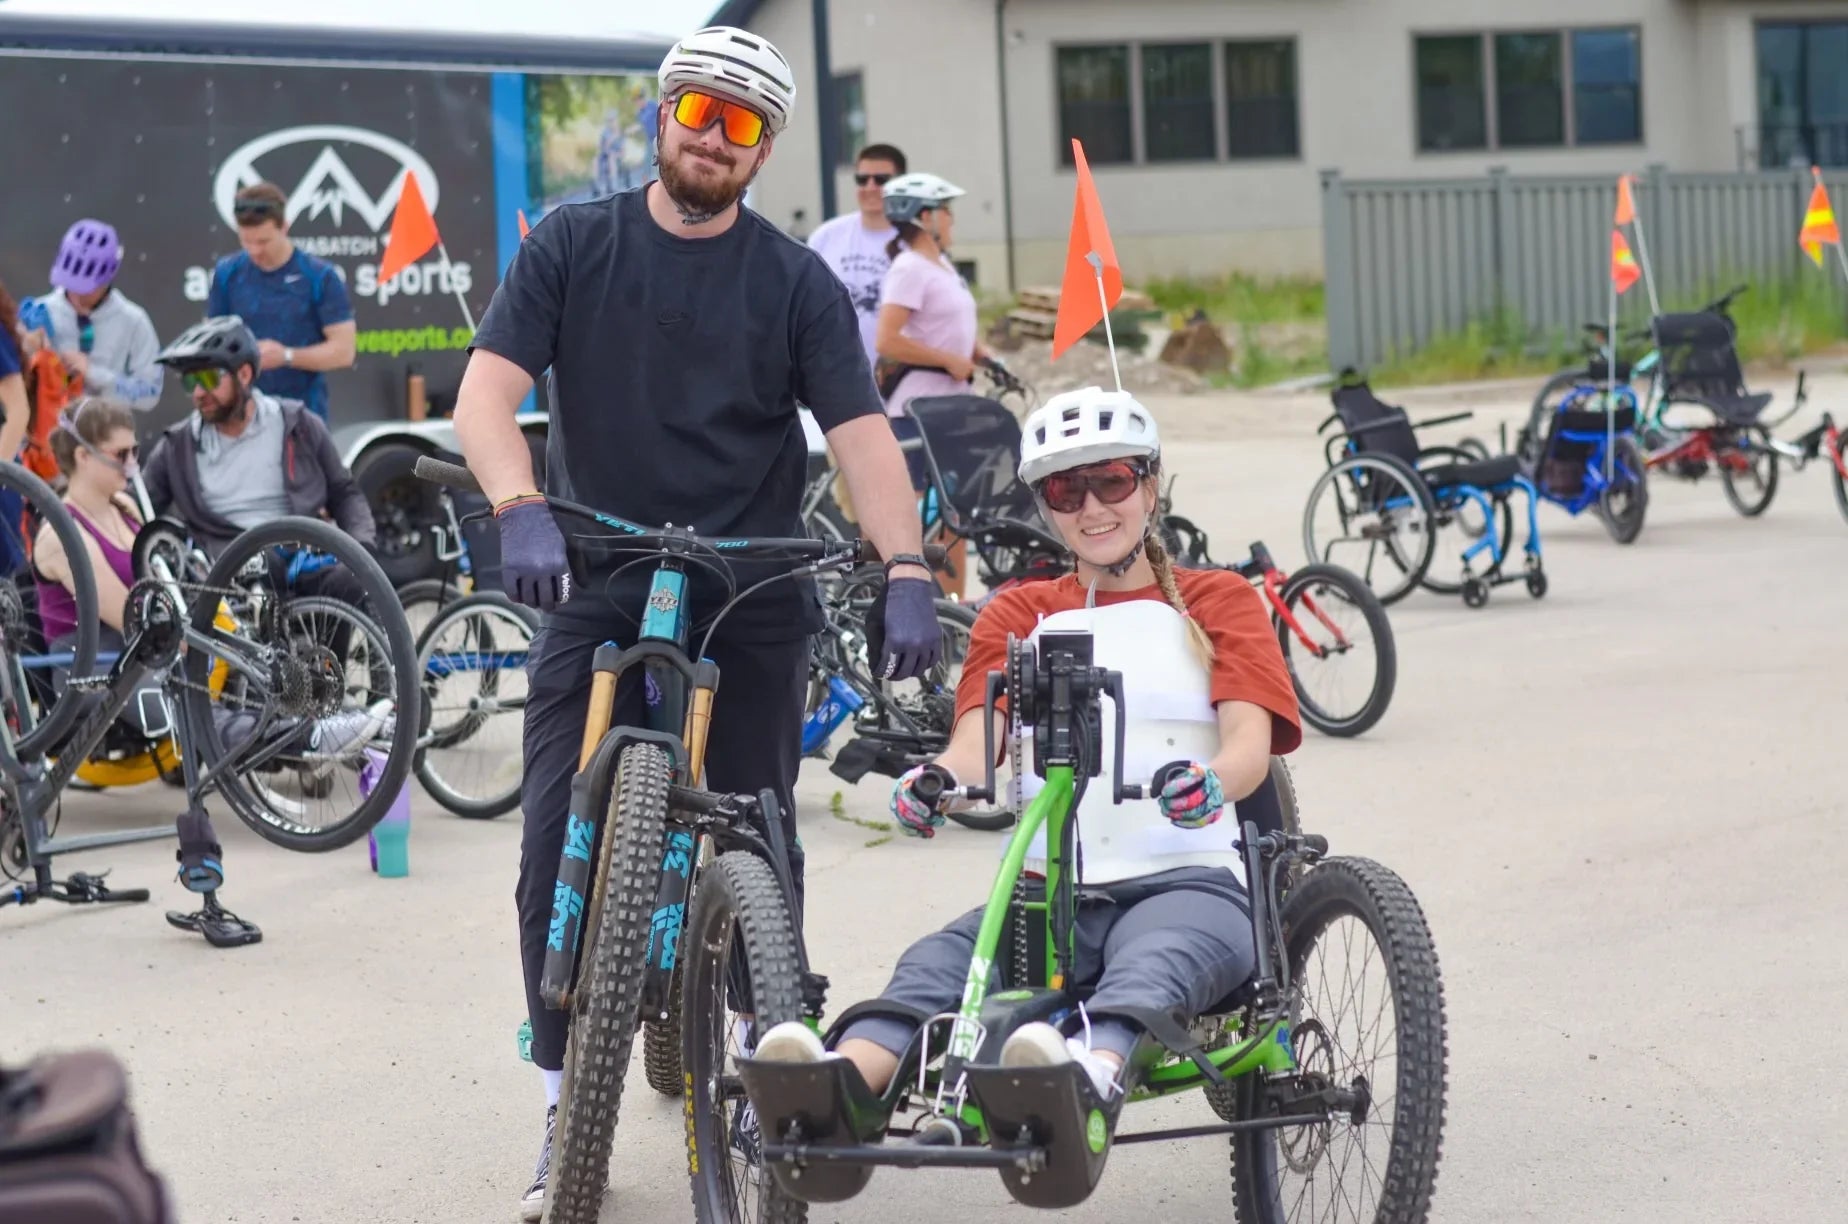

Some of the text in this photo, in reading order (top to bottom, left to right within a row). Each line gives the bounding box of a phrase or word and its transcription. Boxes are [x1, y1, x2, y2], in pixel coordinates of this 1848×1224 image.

[354, 259, 473, 306] sports
[564, 814, 594, 862] 34
[685, 1072, 699, 1173] MAXXIS
